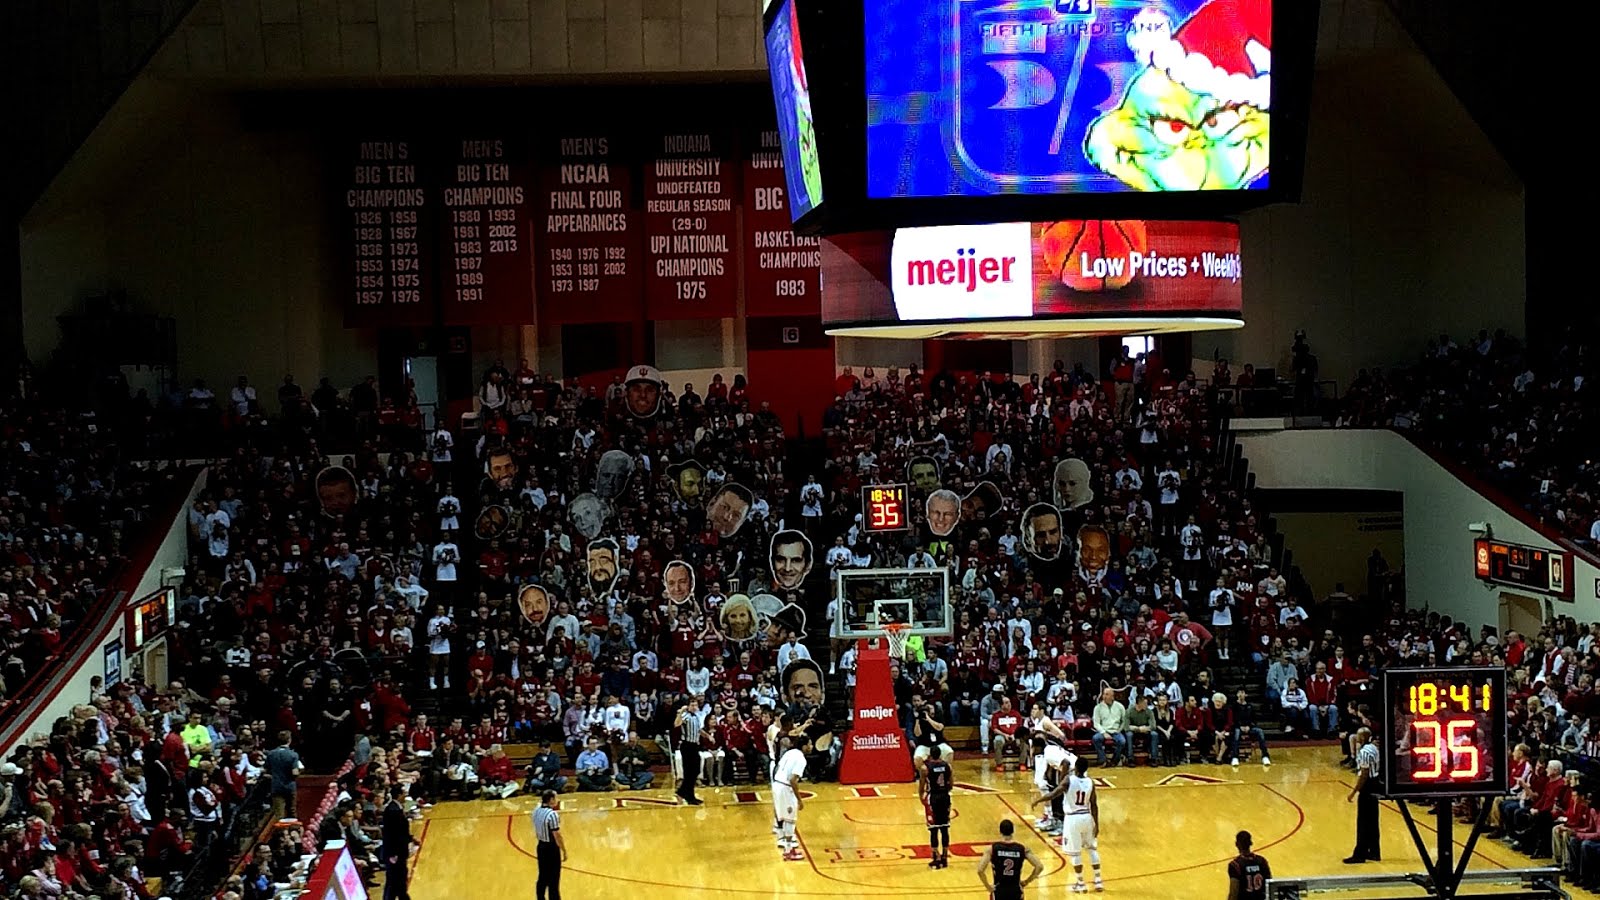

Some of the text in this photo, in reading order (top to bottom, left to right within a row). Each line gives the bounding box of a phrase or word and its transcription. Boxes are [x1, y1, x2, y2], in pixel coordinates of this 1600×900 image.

[981, 21, 1166, 36] FIFTH THIRD BANK
[360, 141, 408, 160] MEN'S
[463, 139, 503, 158] MEN'S
[560, 137, 609, 156] MEN'S
[664, 134, 711, 153] INDIANA
[354, 164, 415, 184] BIG TEN
[457, 163, 509, 182] BIG TEN
[561, 163, 609, 184] NCAA
[655, 157, 721, 176] UNIVERSITY
[444, 186, 524, 206] CHAMPIONS
[656, 181, 720, 194] UNDEFEATED
[346, 188, 424, 208] CHAMPIONS
[551, 190, 622, 210] FINAL FOUR
[648, 198, 731, 213] REGULAR SEASON
[755, 187, 784, 211] BIG
[354, 210, 417, 224] 1926 1958
[453, 209, 515, 222] 1980 1993
[547, 213, 627, 233] APPEARANCES
[672, 217, 707, 231] (29-0)
[354, 226, 417, 240] 1928 1967
[453, 225, 517, 238] 1981 2002
[354, 242, 418, 256] 1936 1973
[454, 240, 517, 254] 1983 2013
[651, 234, 729, 254] UPI NATIONAL
[551, 247, 626, 260] 1940 1976 1992
[760, 251, 821, 269] CHAMPIONS
[355, 258, 419, 272] 1953 1974
[455, 257, 482, 270] 1987
[551, 262, 626, 276] 1953 1981 2002
[656, 257, 724, 277] CHAMPIONS
[907, 248, 1016, 292] meijer
[1081, 251, 1125, 278] Low
[1129, 250, 1188, 277] Prices
[355, 274, 420, 288] 1954 1975
[455, 272, 483, 286] 1989
[551, 279, 599, 292] 1973 1987
[776, 279, 806, 296] 1983
[356, 290, 420, 304] 1957 1976
[456, 288, 483, 301] 1991
[676, 281, 707, 300] 1975
[871, 489, 902, 502] 18:41
[872, 503, 899, 525] 35
[1409, 683, 1491, 715] 18:41
[860, 705, 894, 720] meijer
[853, 733, 898, 745] Smithville
[1411, 719, 1479, 778] 35
[1075, 790, 1086, 806] 11
[1003, 858, 1015, 876] 2
